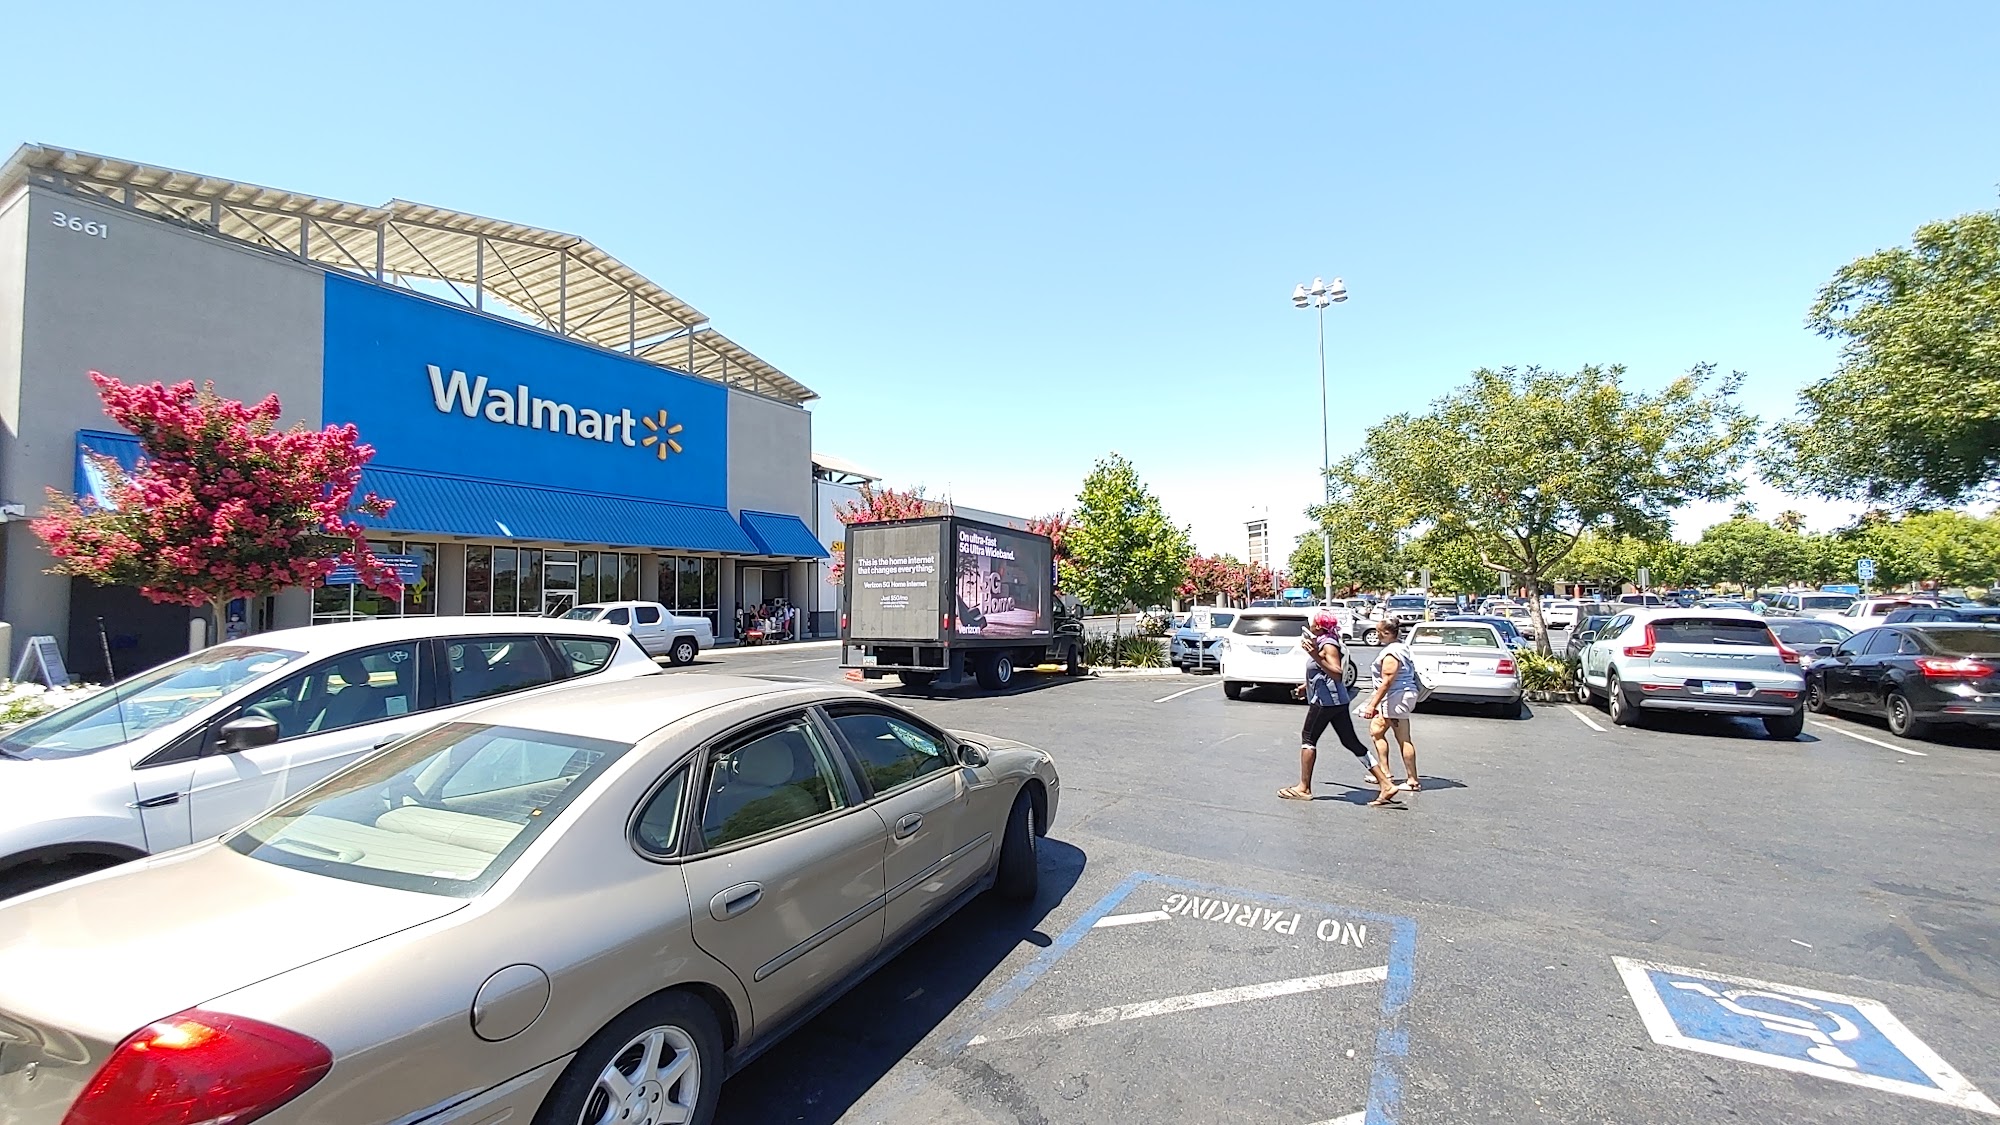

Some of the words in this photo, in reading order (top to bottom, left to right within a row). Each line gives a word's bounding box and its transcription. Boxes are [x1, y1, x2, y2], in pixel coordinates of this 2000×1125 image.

[52, 211, 108, 239] 3661
[427, 364, 637, 447] Walmart
[959, 531, 969, 541] On
[970, 534, 997, 547] ultra-fast
[858, 558, 871, 566] This
[872, 558, 878, 566] is
[878, 557, 888, 566] the
[889, 557, 907, 565] home
[908, 555, 935, 564] internet
[959, 542, 969, 553] 5G
[970, 544, 985, 556] Ultra
[985, 546, 1015, 560] Wideband.
[858, 567, 870, 575] that
[871, 566, 897, 575] changes
[898, 564, 935, 574] everything.
[980, 571, 1001, 594] 5G
[980, 593, 1015, 615] Home
[959, 624, 980, 635] verizon
[1161, 893, 1301, 935] PARKING
[1316, 918, 1367, 949] NO
